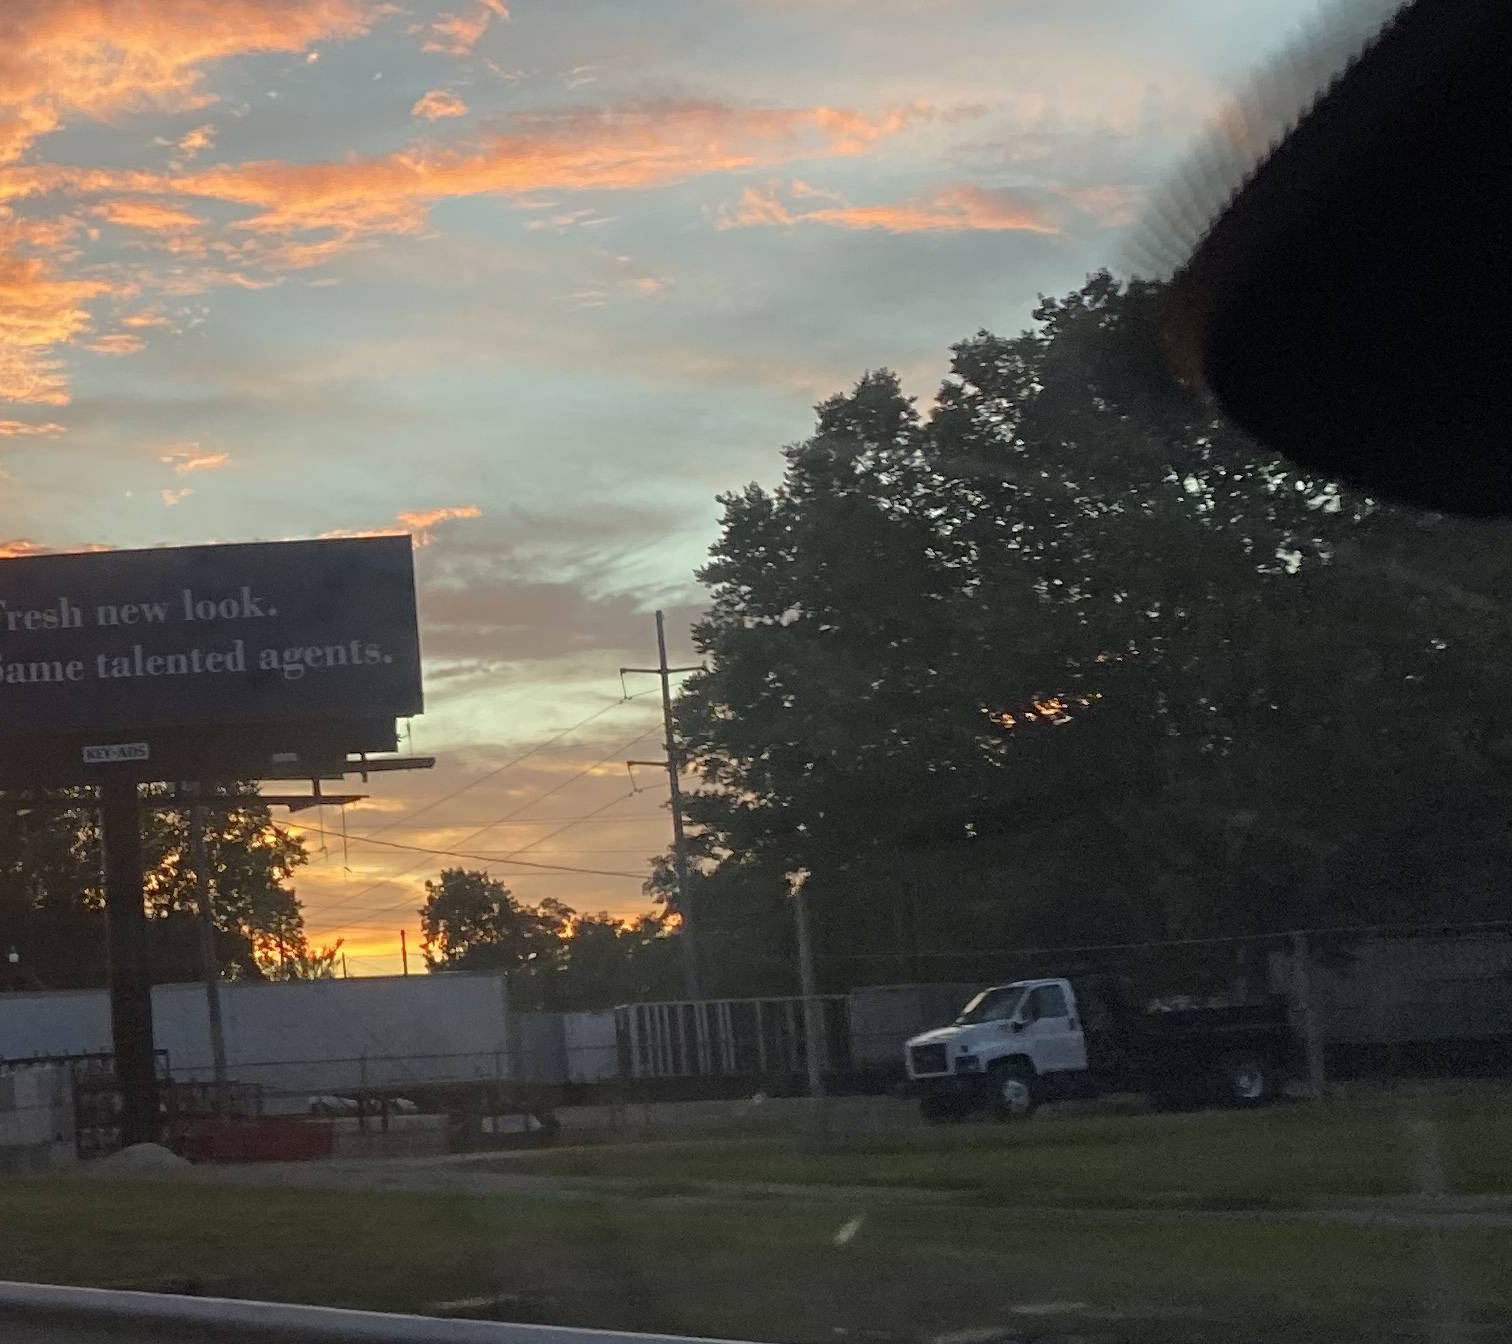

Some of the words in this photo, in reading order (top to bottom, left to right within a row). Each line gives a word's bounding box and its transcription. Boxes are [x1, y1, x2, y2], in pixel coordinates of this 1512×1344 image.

[96, 602, 170, 627] new
[183, 586, 277, 621] look.
[97, 639, 246, 678] talented
[259, 640, 392, 679] agents.
